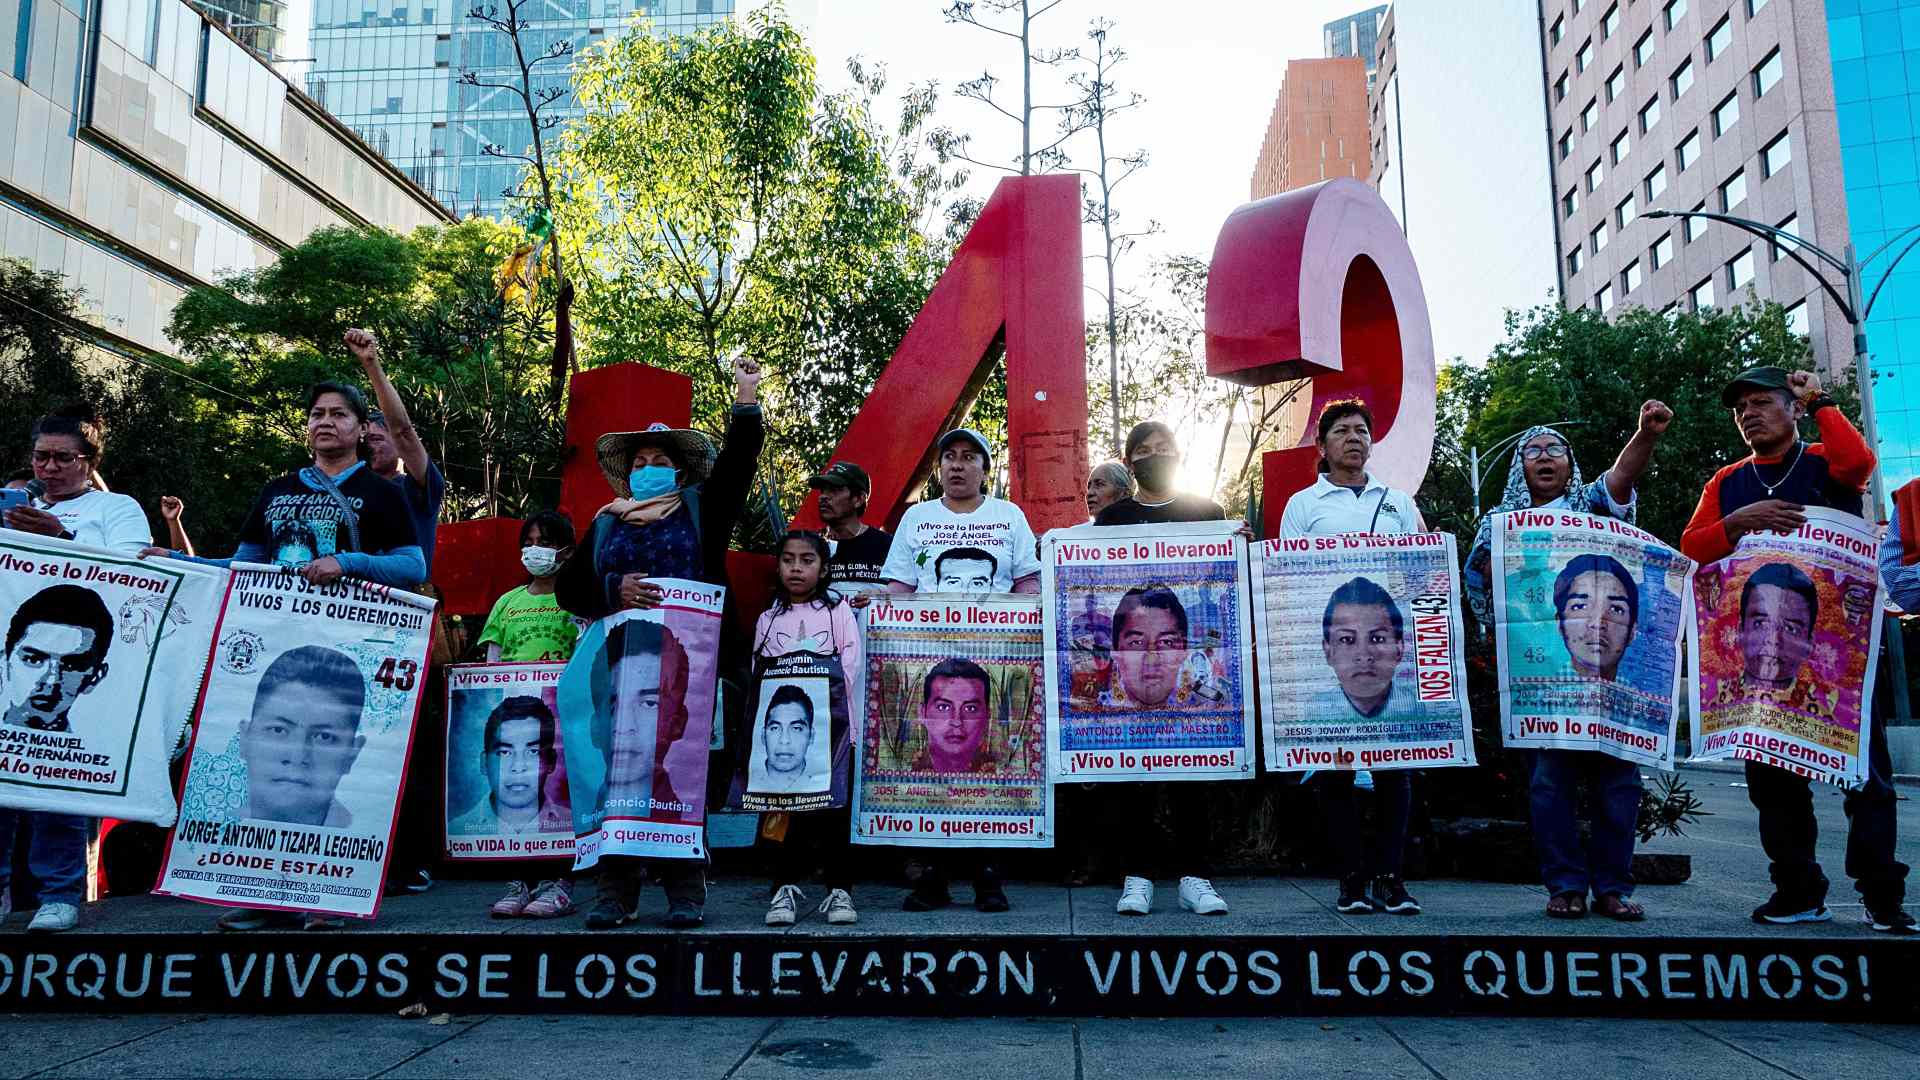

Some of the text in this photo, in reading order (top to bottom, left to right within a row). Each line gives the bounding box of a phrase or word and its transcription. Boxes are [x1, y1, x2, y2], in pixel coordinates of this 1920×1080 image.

[304, 494, 364, 509] ANTOO
[300, 506, 360, 522] LEGIDE
[1508, 511, 1554, 530] ¡Vivo
[1561, 515, 1582, 527] se
[1588, 517, 1604, 530] lo
[917, 523, 942, 532] ¡Vivo
[969, 523, 1010, 531] llevaron!
[934, 530, 994, 539] JOSÉ ÁNGEL
[1057, 539, 1233, 565] ¡Vivo se lo llevaron!
[1265, 533, 1443, 557] ¡Vivo se lo llevaron!
[1798, 524, 1877, 560] llevaron!
[38, 563, 59, 576] se
[63, 563, 82, 578] lo
[85, 565, 169, 593] llevaron!
[856, 570, 878, 579] MÉXICO
[240, 591, 423, 629] VIVOS LOS QUEREMOS!!!
[870, 603, 1043, 625] ¡Vivo se lo llevaron!
[1410, 593, 1451, 700] NOS FALTAN 43!
[374, 657, 418, 691] 43
[454, 670, 560, 687] ¡Vivo se lo llev
[792, 665, 829, 674] Bautista
[0, 730, 85, 750] SAR MANUEL
[1075, 724, 1229, 736] ANTONIO SANTANA MAESTRO
[1520, 717, 1658, 751] ¡Vivo lo queremos!
[26, 747, 110, 766] HERNÁNDEZ
[1071, 750, 1235, 773] ¡Vivo lo queremos!
[1286, 743, 1455, 767] ¡Vivo lo queremos!
[1703, 734, 1726, 754] ¡Vivo
[1728, 730, 1738, 744] lo
[1743, 731, 1847, 771] queremos!
[12, 758, 30, 774] lo
[33, 764, 116, 784] queremos!
[649, 799, 693, 812] Bautista
[742, 794, 765, 804] Vivos
[615, 829, 696, 845] queremos!
[869, 815, 1034, 837] ¡Vivo lo queremos!
[179, 819, 384, 862] JORGE ANTONIO TIZAPA LEGIDEÑO
[476, 840, 506, 852] VIDA
[510, 839, 520, 850] lo
[525, 840, 547, 853] que
[197, 850, 354, 878] ¿DÓNDE ESTÁN?
[171, 869, 372, 898] CONTRA EL TERRORISMO DE ESTADO, LA SOLIDARIDAD
[217, 886, 265, 898] AYOTZINAPA
[293, 891, 320, 903] TODOS
[220, 953, 410, 998] VIVOS
[434, 953, 511, 998] SE
[537, 953, 658, 998] LOS
[1084, 950, 1281, 998] VIVOS
[1308, 950, 1435, 997] LOS
[1463, 950, 1872, 1001] QUEREMOS!
